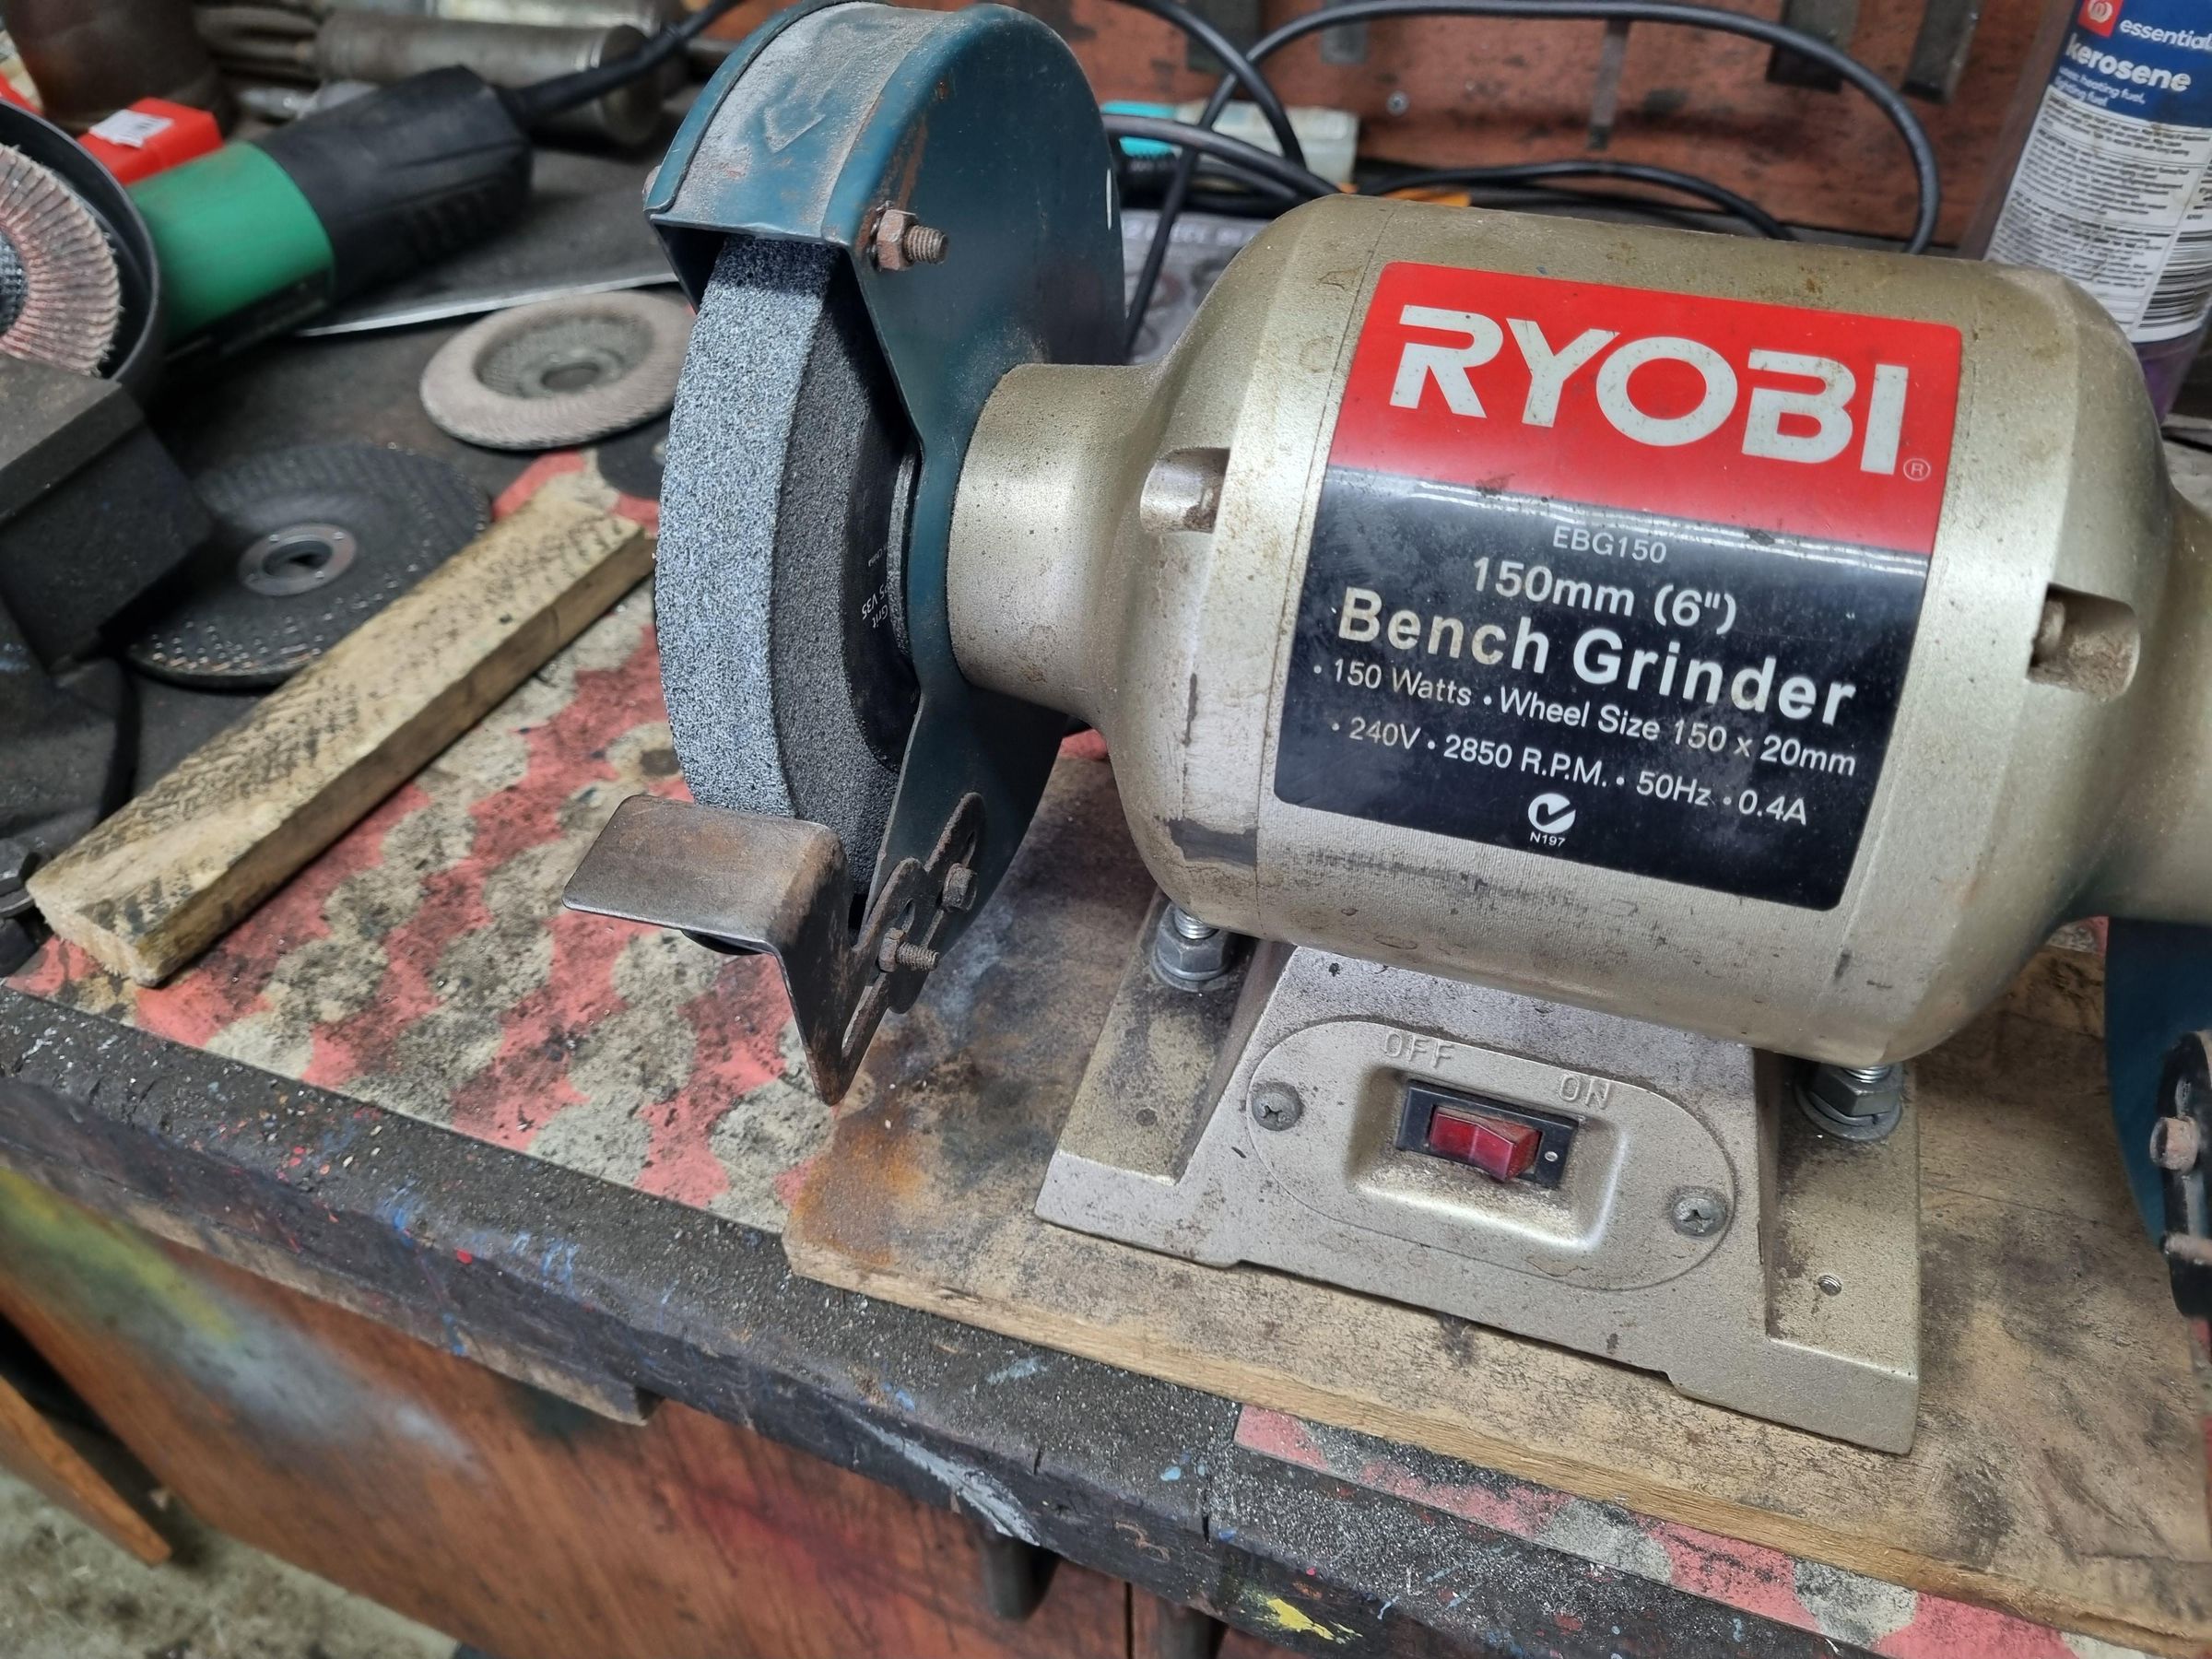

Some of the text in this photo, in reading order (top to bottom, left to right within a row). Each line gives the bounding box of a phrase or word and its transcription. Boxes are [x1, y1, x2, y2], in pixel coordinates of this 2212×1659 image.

[2065, 32, 2191, 91] kerosene
[1390, 304, 1909, 476] RYOBI
[1553, 524, 1666, 564] EBG150
[872, 604, 888, 628] Grit
[1475, 557, 1736, 634] 150mm (6")
[1338, 586, 1856, 726] Bench Grinder
[1335, 659, 1856, 776] 150 Watts Wheel Size 150 x 20mm
[1349, 716, 1806, 826] 240V 2850 R.P.M. 50Hz 0.4A
[1530, 831, 1566, 847] N197
[1384, 1031, 1454, 1068] OFF
[1559, 1073, 1609, 1110] ON
